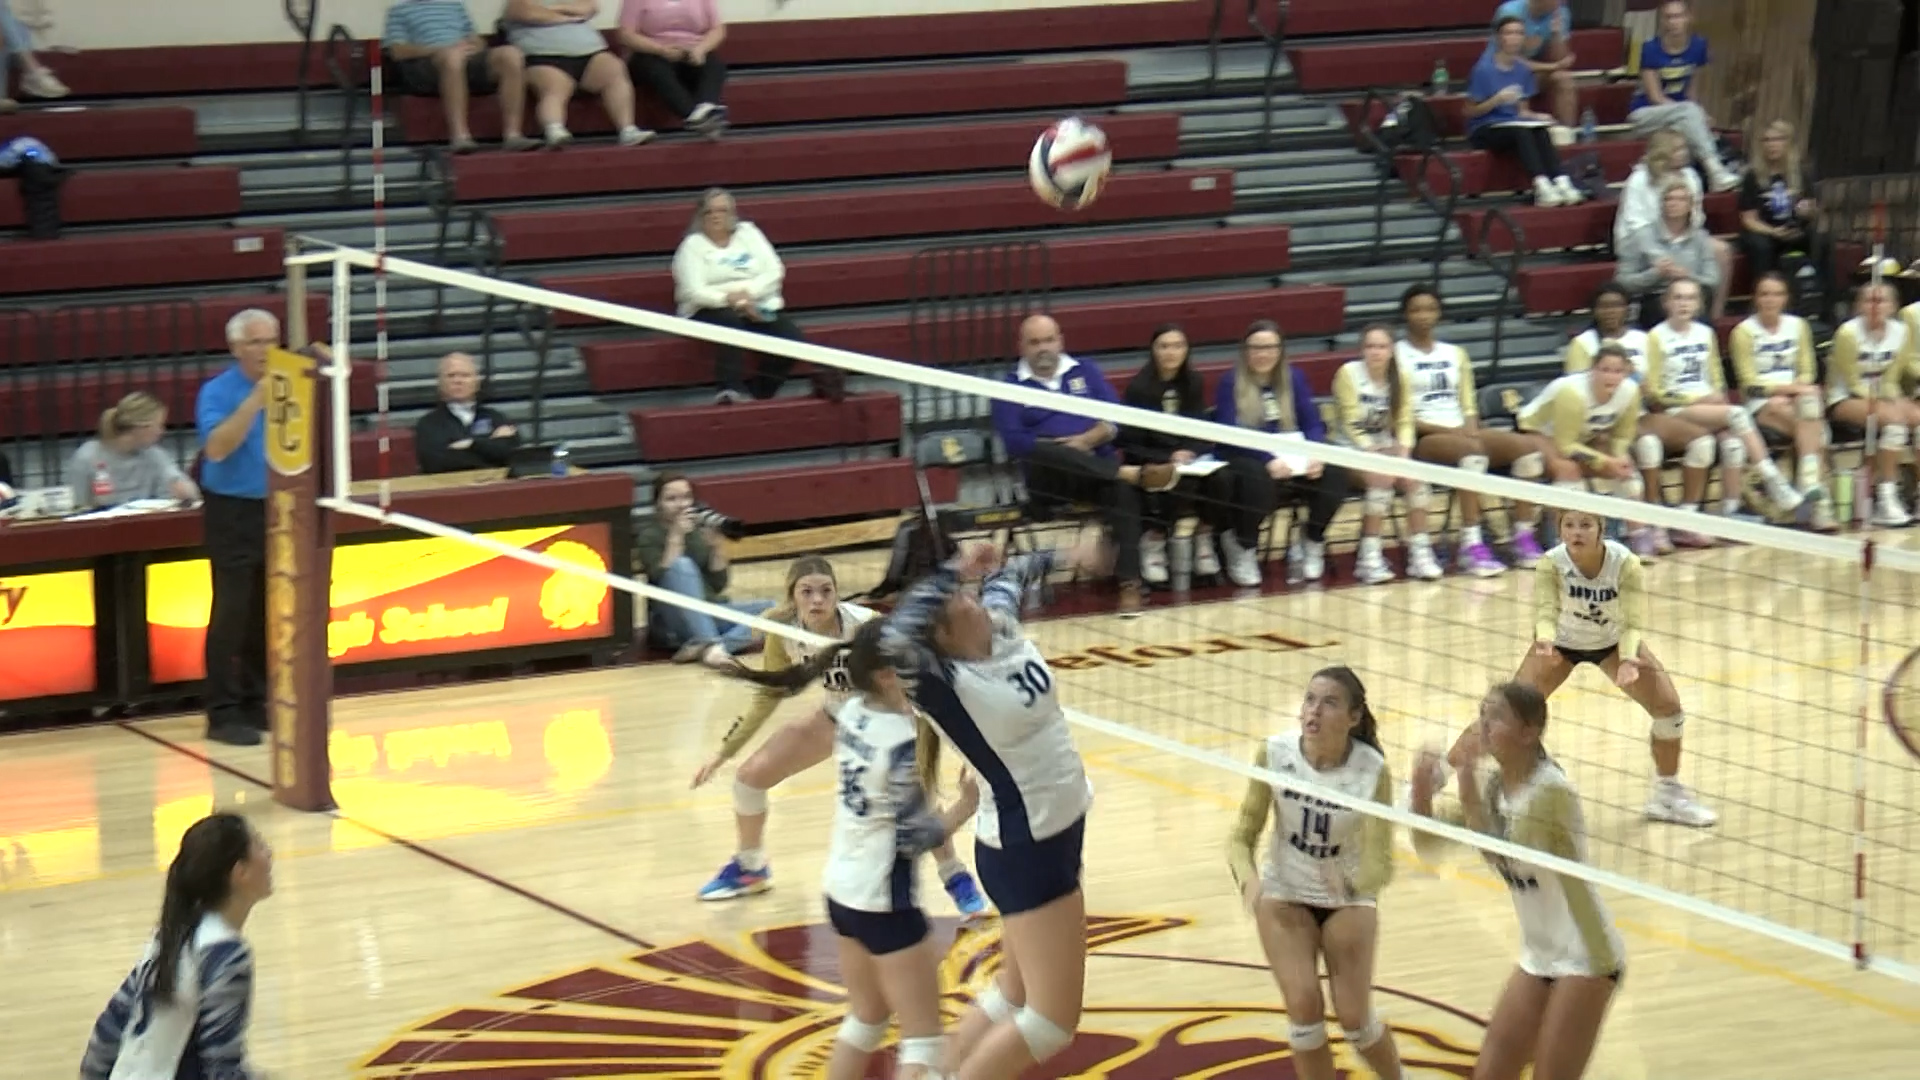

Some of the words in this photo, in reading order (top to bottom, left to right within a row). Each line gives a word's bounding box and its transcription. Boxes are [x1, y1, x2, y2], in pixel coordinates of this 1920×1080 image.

[379, 597, 509, 644] School
[1007, 660, 1050, 708] 30
[1302, 807, 1329, 842] 14
